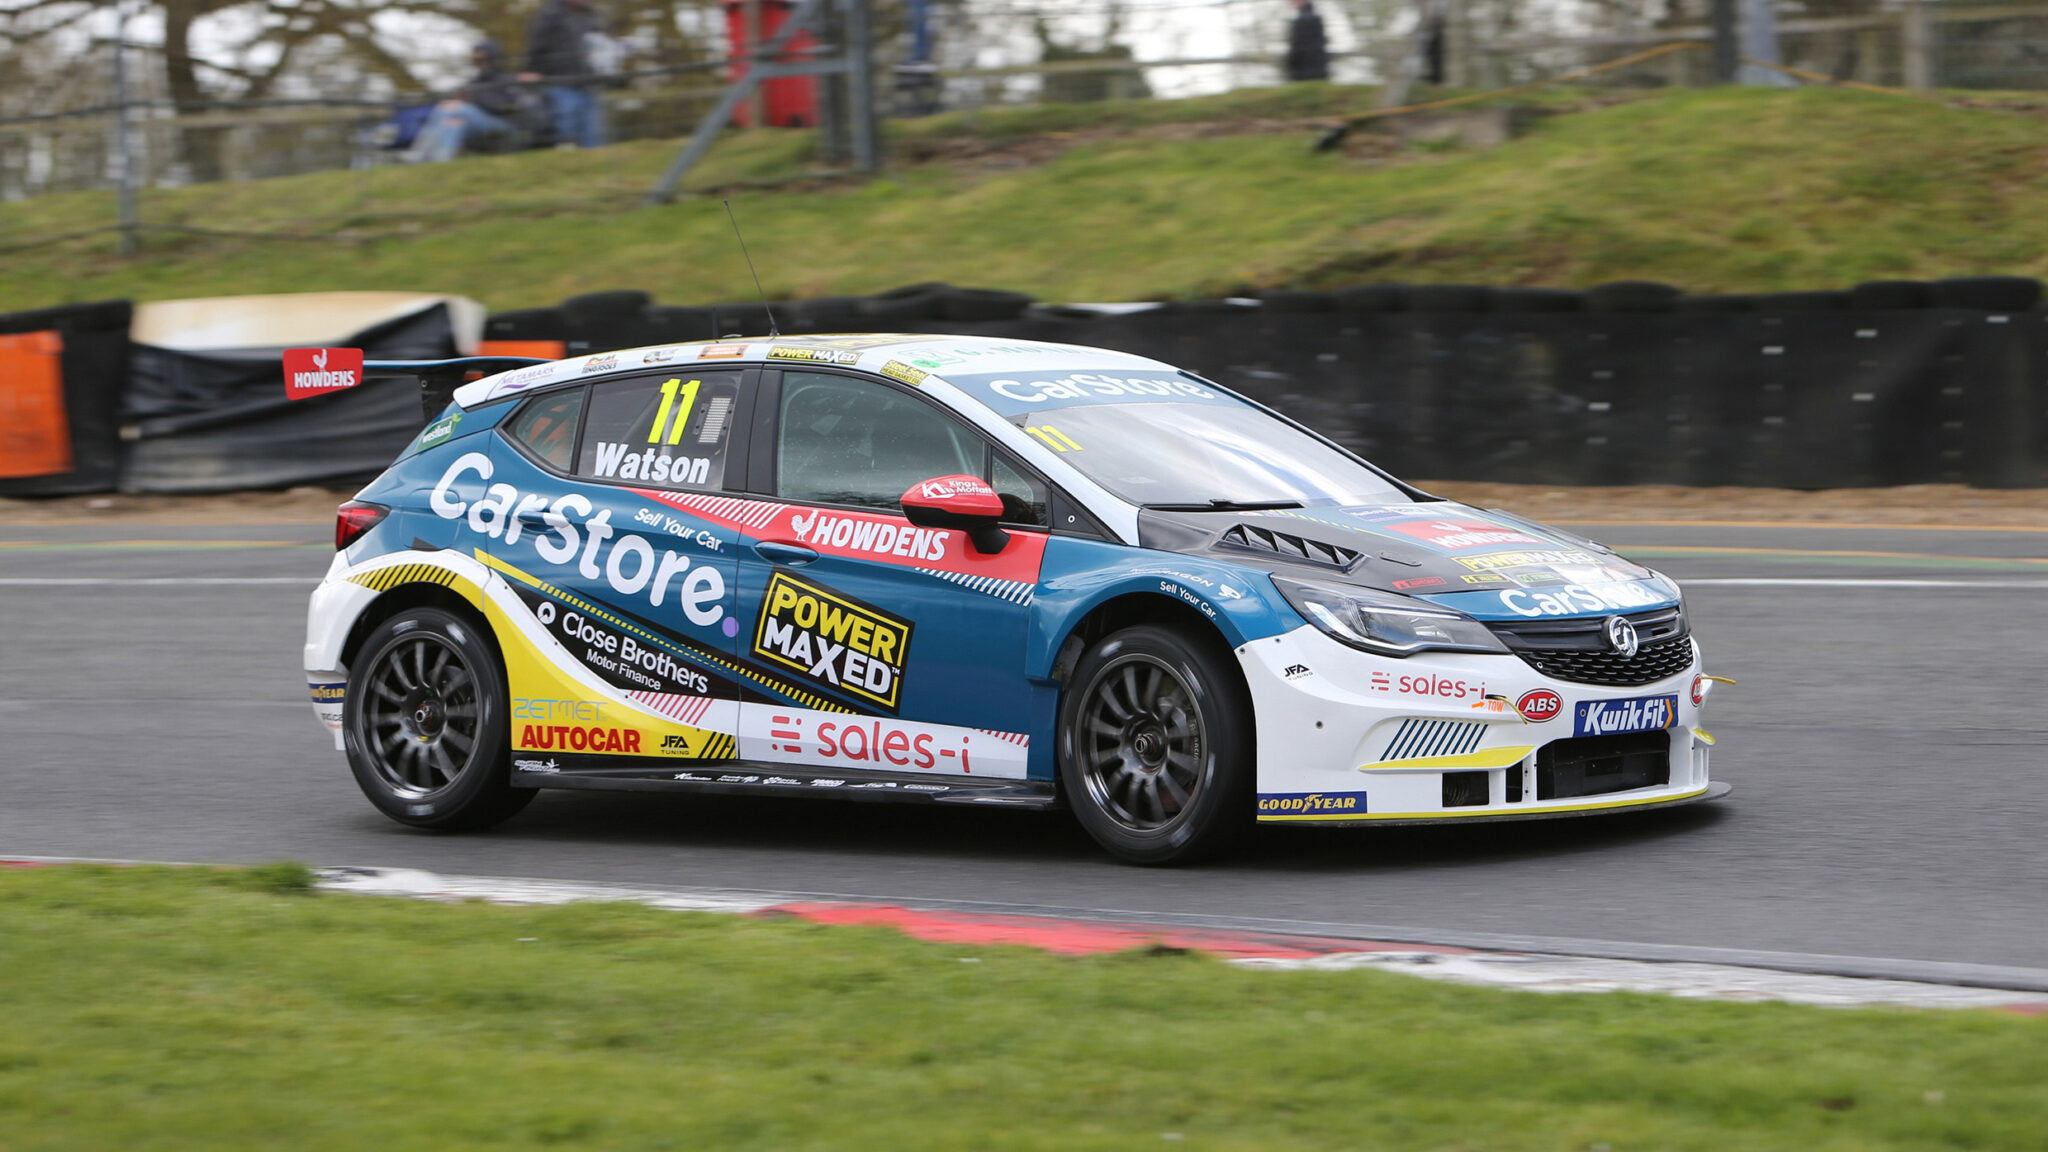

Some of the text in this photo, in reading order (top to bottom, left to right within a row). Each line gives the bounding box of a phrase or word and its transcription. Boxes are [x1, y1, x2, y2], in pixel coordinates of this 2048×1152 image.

[769, 346, 858, 363] POWER MAXED
[293, 369, 356, 389] HOWDENS
[988, 374, 1215, 403] CarStore
[648, 378, 701, 446] 11
[1025, 425, 1084, 453] 11
[594, 442, 711, 485] Watson
[948, 480, 972, 488] King
[633, 507, 661, 527] Sell
[662, 517, 696, 541] Your
[810, 515, 950, 561] HOWDENS
[1459, 552, 1530, 571] POWER
[1159, 580, 1178, 595] Sell
[1179, 587, 1200, 606] Your
[1499, 581, 1666, 617] CarSe
[769, 583, 897, 664] POWER
[562, 612, 709, 694] Close Brothers
[762, 616, 892, 695] MAXED
[586, 648, 662, 691] Motor Finance
[1284, 663, 1310, 678] JFA
[1398, 673, 1487, 701] sales-i
[513, 698, 608, 721] ZETMET
[1487, 700, 1504, 713] TOW
[1523, 697, 1558, 714] ABS
[520, 724, 642, 754] AUTOCAR
[660, 735, 689, 749] JFA
[816, 720, 971, 774] sales-i
[1257, 795, 1357, 812] GOODYEAR
